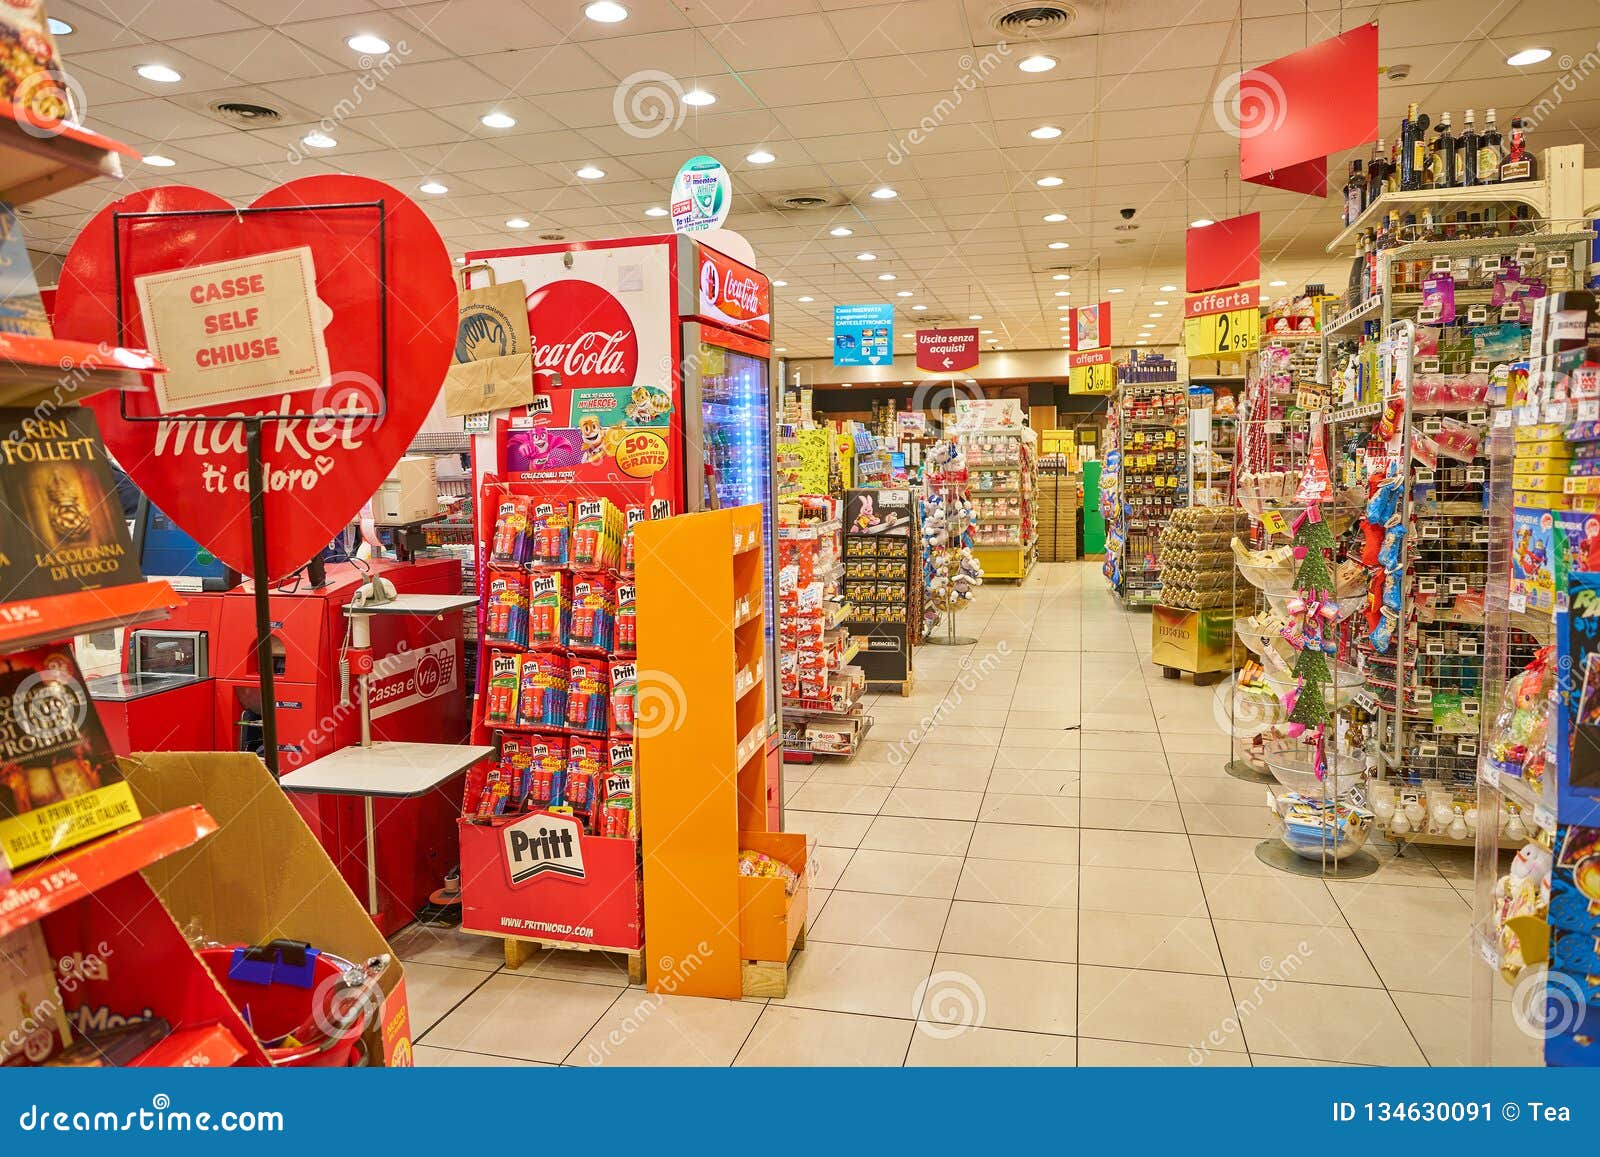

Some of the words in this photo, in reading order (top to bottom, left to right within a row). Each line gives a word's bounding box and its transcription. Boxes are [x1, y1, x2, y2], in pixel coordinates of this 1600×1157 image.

[190, 274, 265, 304] CASSE
[723, 269, 759, 314] Coca-Cola
[1193, 293, 1250, 313] offerta
[204, 308, 259, 334] SELF
[920, 335, 947, 344] Uscita
[948, 334, 974, 343] senza
[1218, 314, 1230, 351] 2
[1234, 334, 1248, 348] 95
[196, 337, 280, 367] CHIUSE
[531, 330, 632, 376] oca-Cola
[930, 344, 965, 355] acquisti
[1076, 353, 1103, 364] offerta
[1087, 366, 1094, 390] 3
[588, 398, 617, 408] HEROES
[25, 419, 68, 439] KEN
[6, 438, 96, 465] FOLLETT
[625, 435, 659, 454] 50%
[621, 455, 665, 470] GRATIS
[202, 462, 228, 493] ti
[500, 504, 514, 513] Pritt
[536, 505, 551, 514] Pritt
[580, 501, 601, 515] Pritt
[57, 543, 125, 565] COLONNA
[51, 565, 69, 581] DI
[72, 559, 119, 578] FUOCO
[492, 581, 505, 589] Pritt
[534, 578, 555, 591] Pritt
[576, 584, 589, 593] Pritt
[494, 659, 515, 672] Pritt
[523, 663, 537, 671] Pritt
[572, 668, 585, 676] Pritt
[614, 667, 635, 681] Pritt
[406, 678, 414, 691] e
[504, 743, 517, 751] Pritt
[534, 746, 547, 754] Pritt
[572, 748, 585, 756] Pritt
[611, 747, 633, 760] Pritt
[488, 772, 500, 780] Pritt
[608, 777, 631, 791] Pritt
[510, 828, 574, 862] Pritt
[501, 916, 594, 937] WWW.PRITTWORLD.COM
